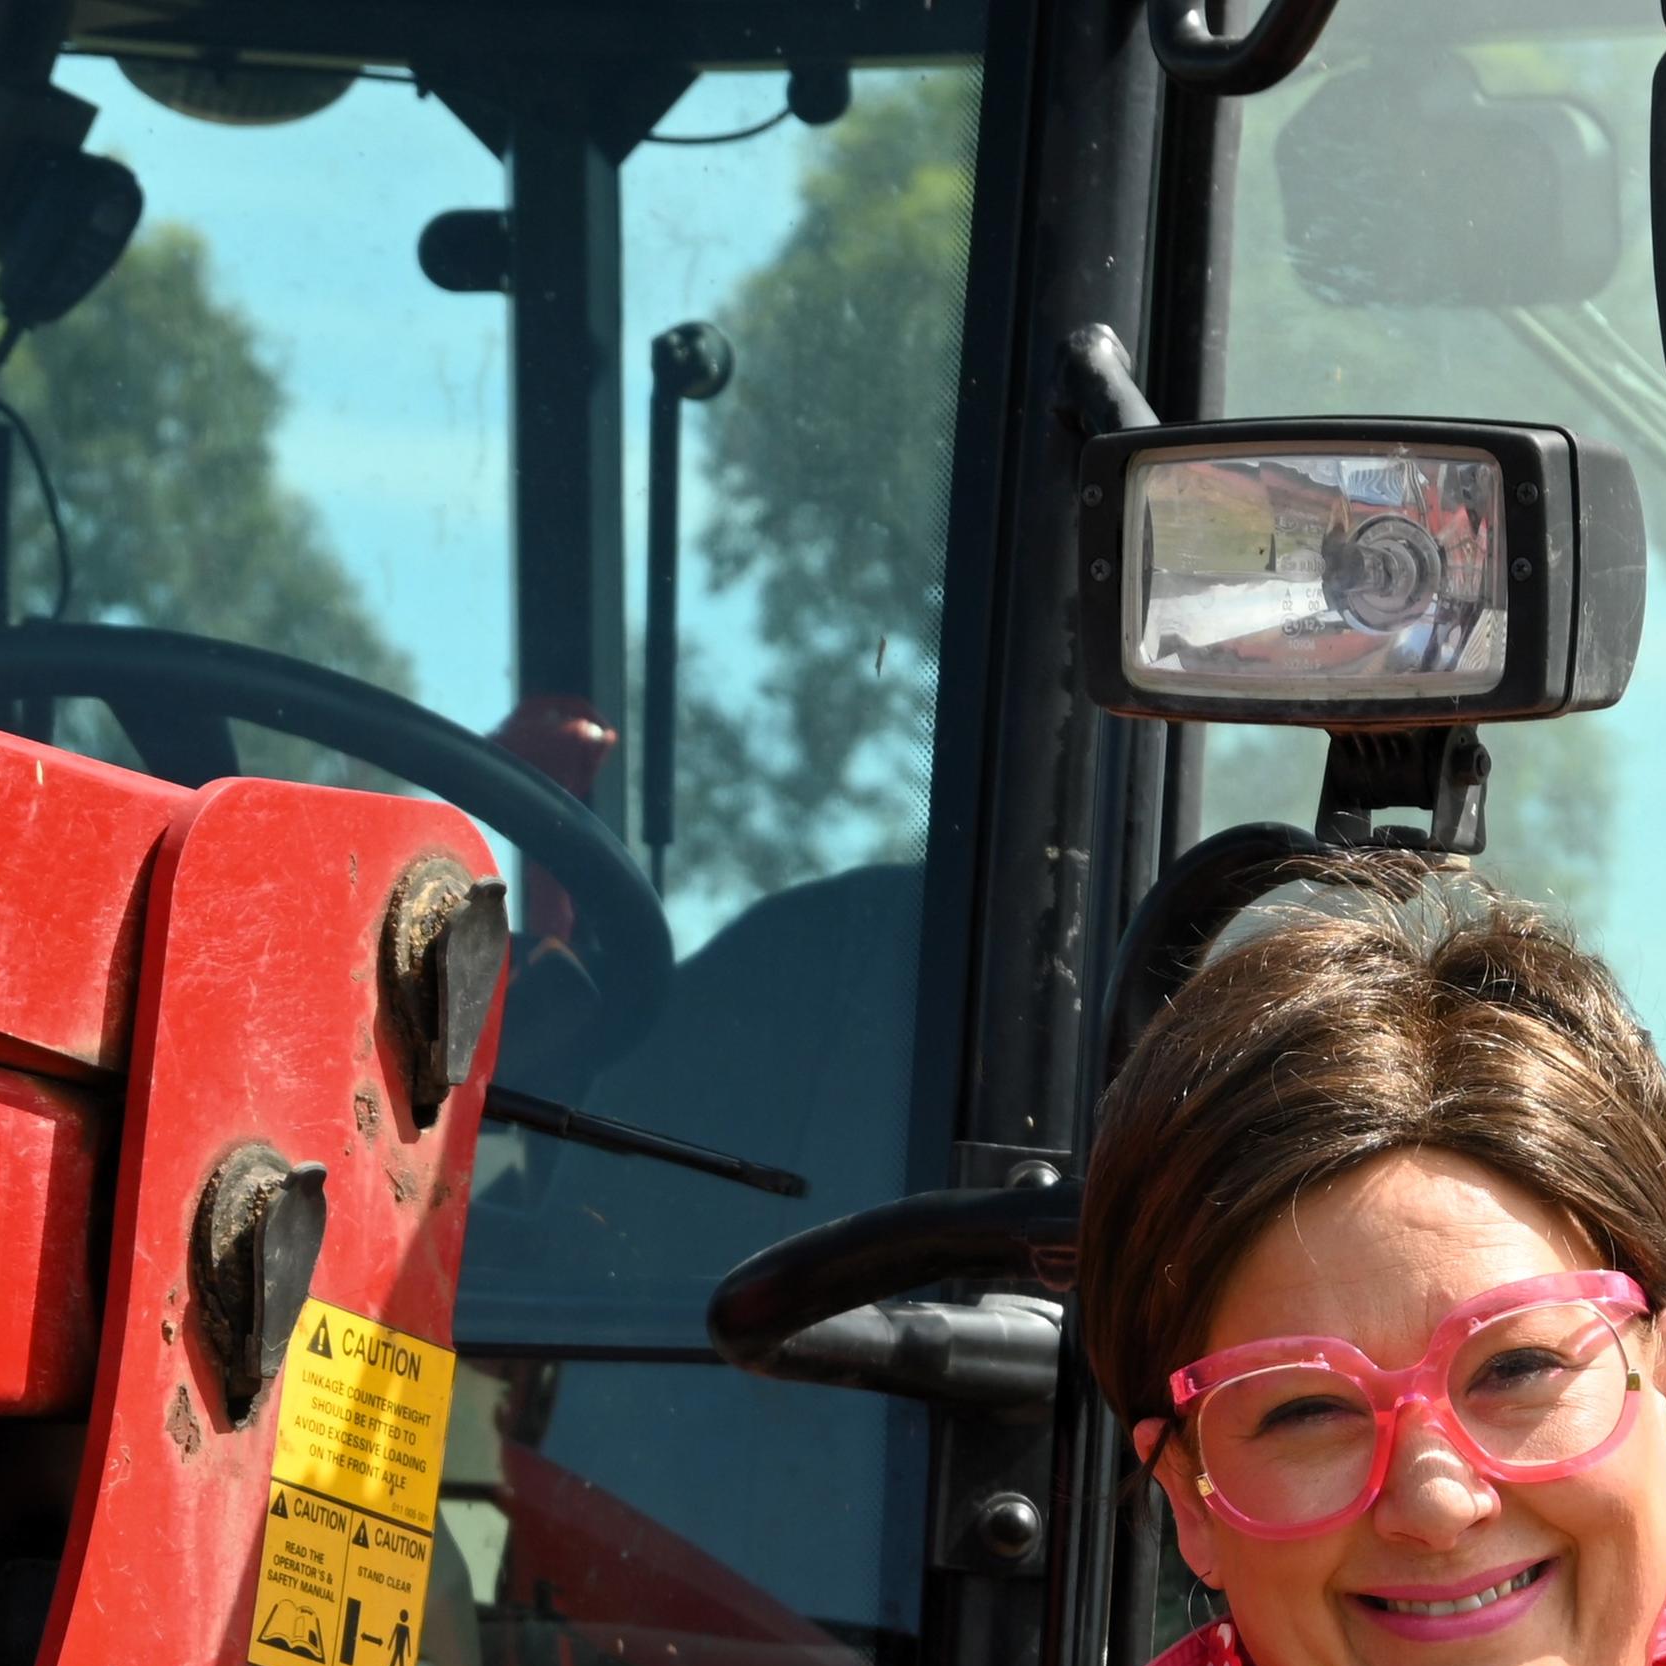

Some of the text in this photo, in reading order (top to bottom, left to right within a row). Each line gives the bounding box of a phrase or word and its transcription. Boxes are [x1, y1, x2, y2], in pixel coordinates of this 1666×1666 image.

[342, 1328, 421, 1382] CAUTION
[302, 1370, 431, 1427] LINKAGE COUNTERWEIGHT
[311, 1397, 416, 1446] SHOULD BE FITTED TO
[294, 1415, 427, 1474] AVOID EXCESSIVE LOADING
[309, 1443, 407, 1490] ON THE FRONT AXLE
[293, 1497, 347, 1534] CAUTION
[285, 1540, 325, 1565] READ THE
[374, 1528, 427, 1562] CAUTION
[267, 1568, 335, 1604] SAFETY MANUAL
[273, 1554, 333, 1585] OPERATOR'S &
[357, 1566, 412, 1594] STAND CLEAR
